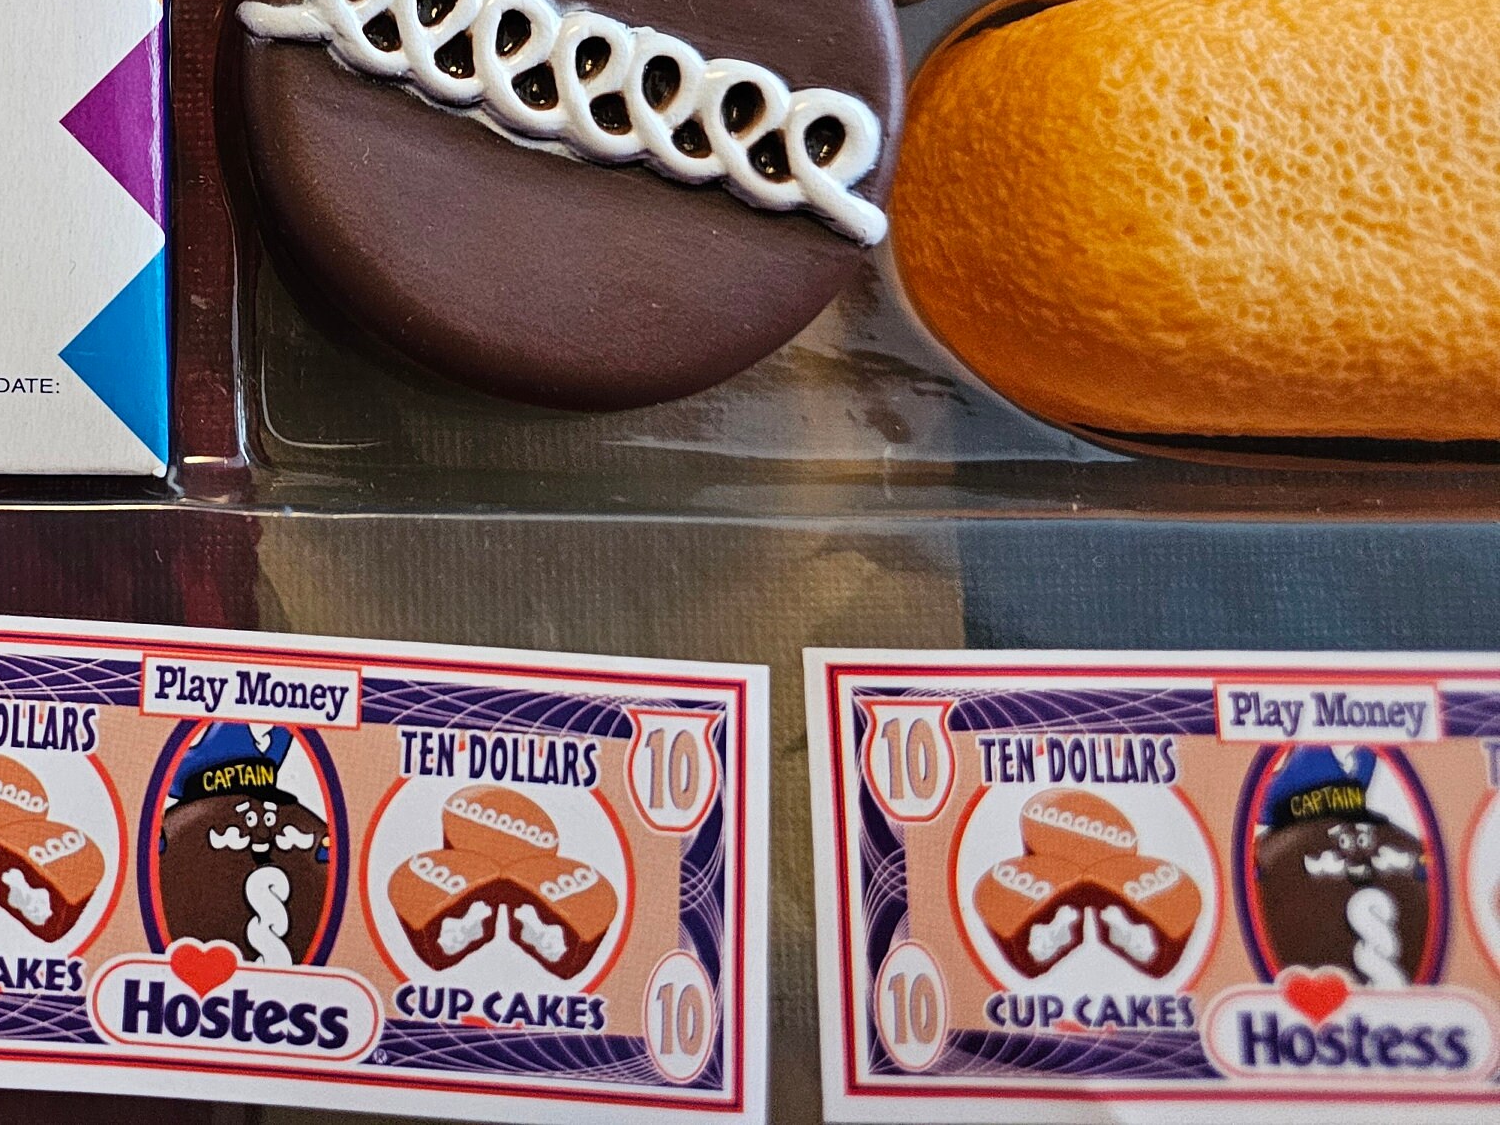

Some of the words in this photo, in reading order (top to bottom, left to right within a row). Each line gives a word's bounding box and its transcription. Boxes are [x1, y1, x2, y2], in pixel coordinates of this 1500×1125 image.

[155, 665, 228, 713] Play
[235, 669, 348, 720] Money
[1229, 691, 1303, 736] Play
[1312, 692, 1425, 737] Money
[203, 763, 274, 792] CAPTAIN
[401, 730, 455, 776] TEN
[470, 737, 598, 787] DOLLARS
[645, 728, 699, 809] 10
[882, 718, 937, 800] 10
[978, 737, 1039, 783] TEN
[1048, 737, 1176, 783] DOLLARS
[1290, 787, 1362, 816] CAPTAIN
[122, 978, 348, 1049] Hostess
[396, 985, 474, 1021] CUP
[484, 991, 604, 1031] CAKES
[657, 982, 700, 1056] 10
[888, 972, 933, 1045] 10
[985, 995, 1062, 1027] CUP
[1072, 995, 1194, 1028] CAKES
[1239, 1012, 1469, 1070] Hostess
